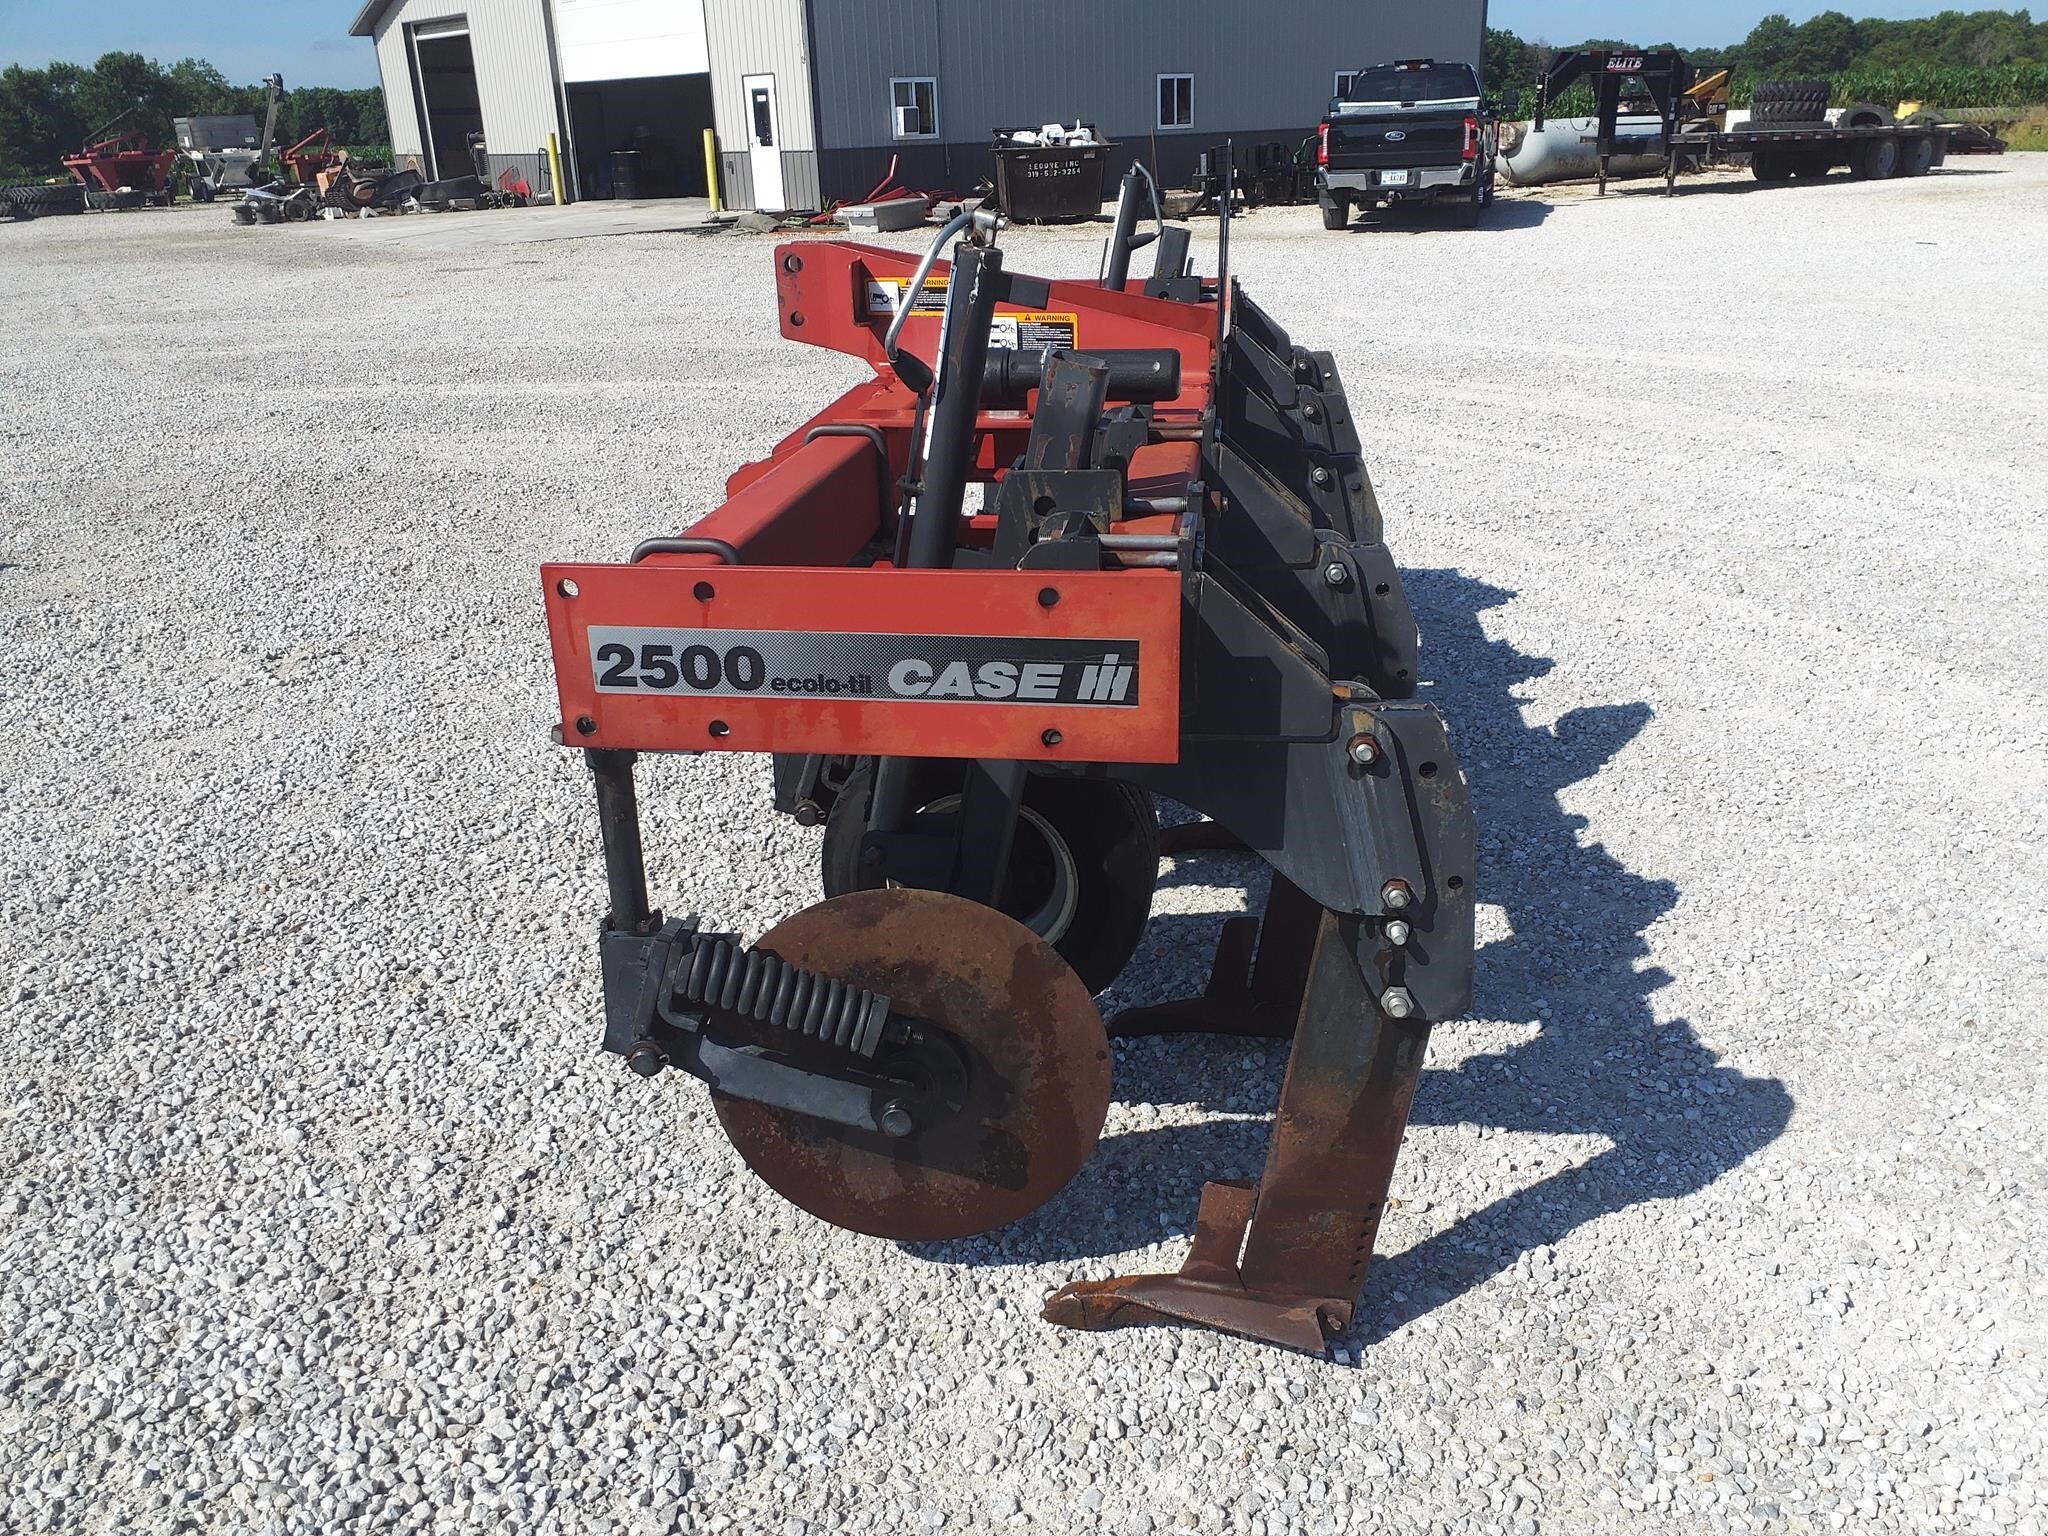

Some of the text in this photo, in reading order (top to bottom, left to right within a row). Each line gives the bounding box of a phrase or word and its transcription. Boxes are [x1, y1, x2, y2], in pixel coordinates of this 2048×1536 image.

[1606, 57, 1643, 69] ELITE
[1065, 160, 1079, 168] INC
[1027, 167, 1081, 178] 319-52-3254
[596, 643, 766, 691] 2500
[770, 674, 872, 694] ecolo-til
[888, 658, 1065, 699] CASE
